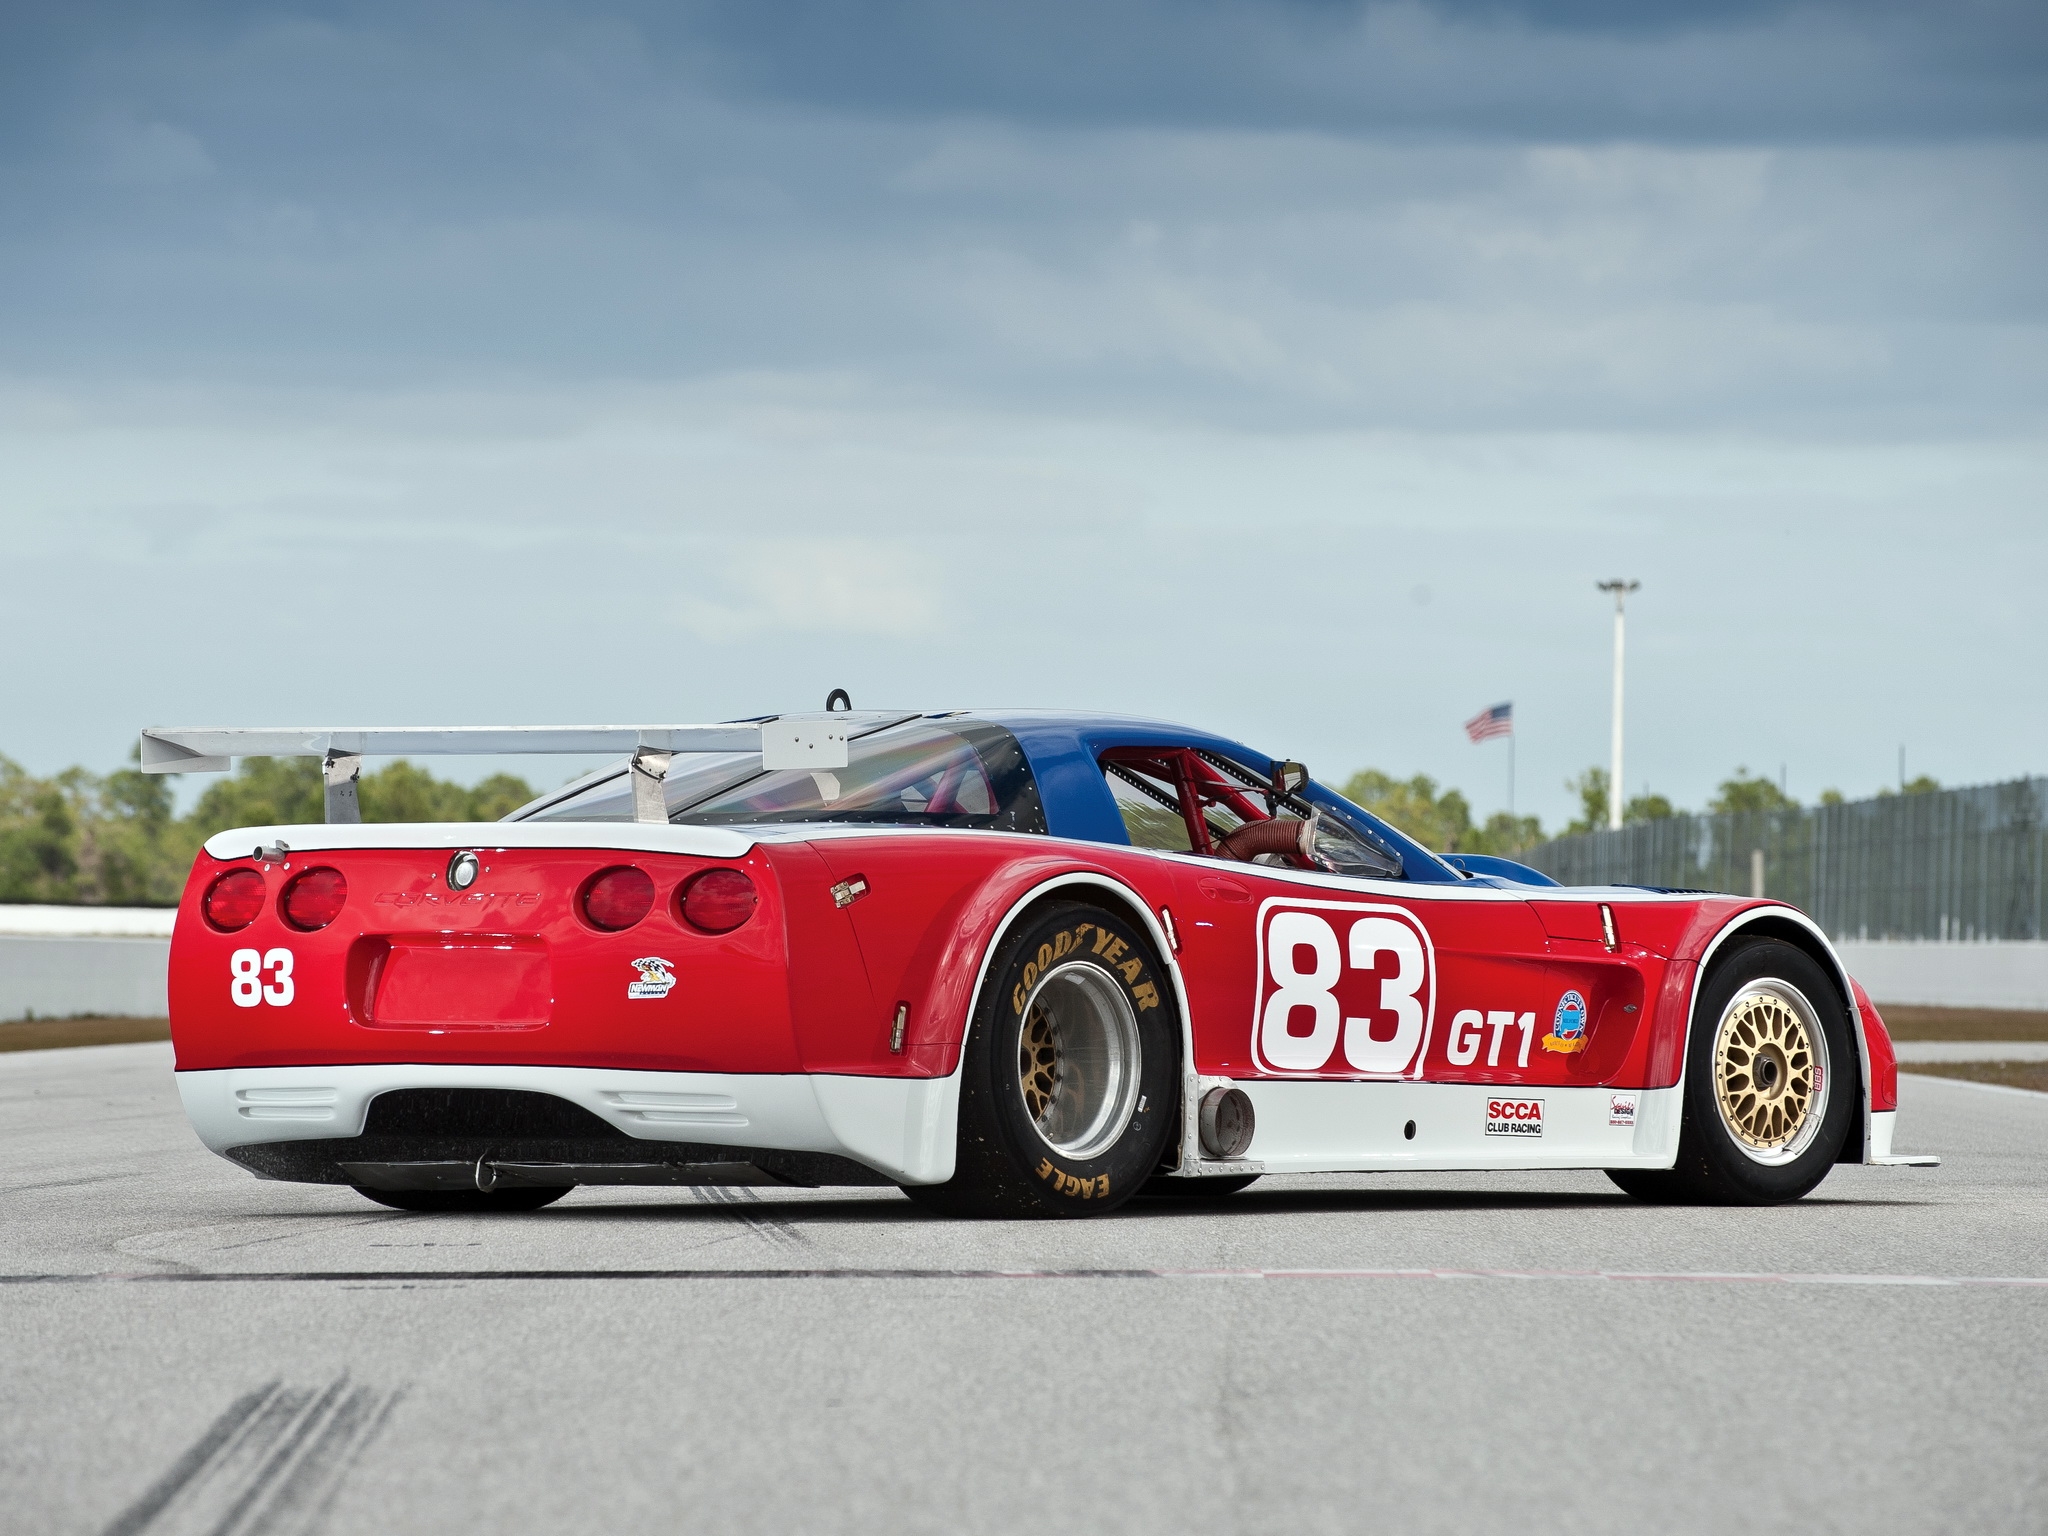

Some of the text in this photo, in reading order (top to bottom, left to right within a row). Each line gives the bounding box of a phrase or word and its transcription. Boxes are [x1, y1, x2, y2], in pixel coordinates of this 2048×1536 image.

[374, 892, 541, 912] CORVETTE
[230, 948, 295, 1008] 83
[630, 983, 667, 993] NEWMAN
[1261, 911, 1425, 1073] 83
[1446, 1009, 1536, 1068] GT1
[1488, 1101, 1541, 1120] SCCA
[1487, 1122, 1541, 1134] CLUB RACING
[1035, 1157, 1110, 1200] EAGLE
